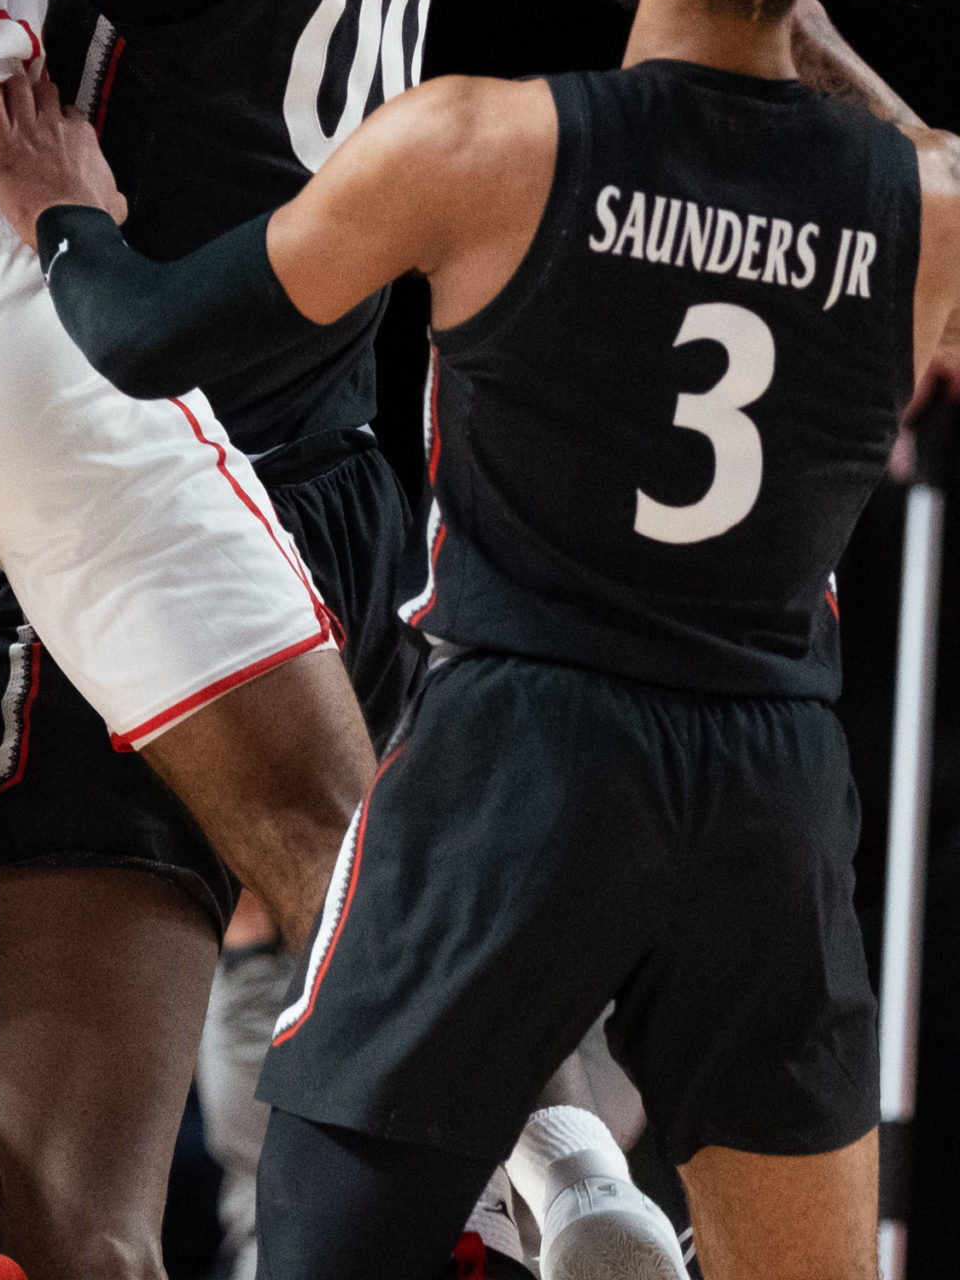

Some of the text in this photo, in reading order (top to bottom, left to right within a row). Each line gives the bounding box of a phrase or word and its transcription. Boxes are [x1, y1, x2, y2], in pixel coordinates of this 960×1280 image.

[588, 185, 877, 312] SAUNDERS JR
[633, 302, 776, 544] 3
